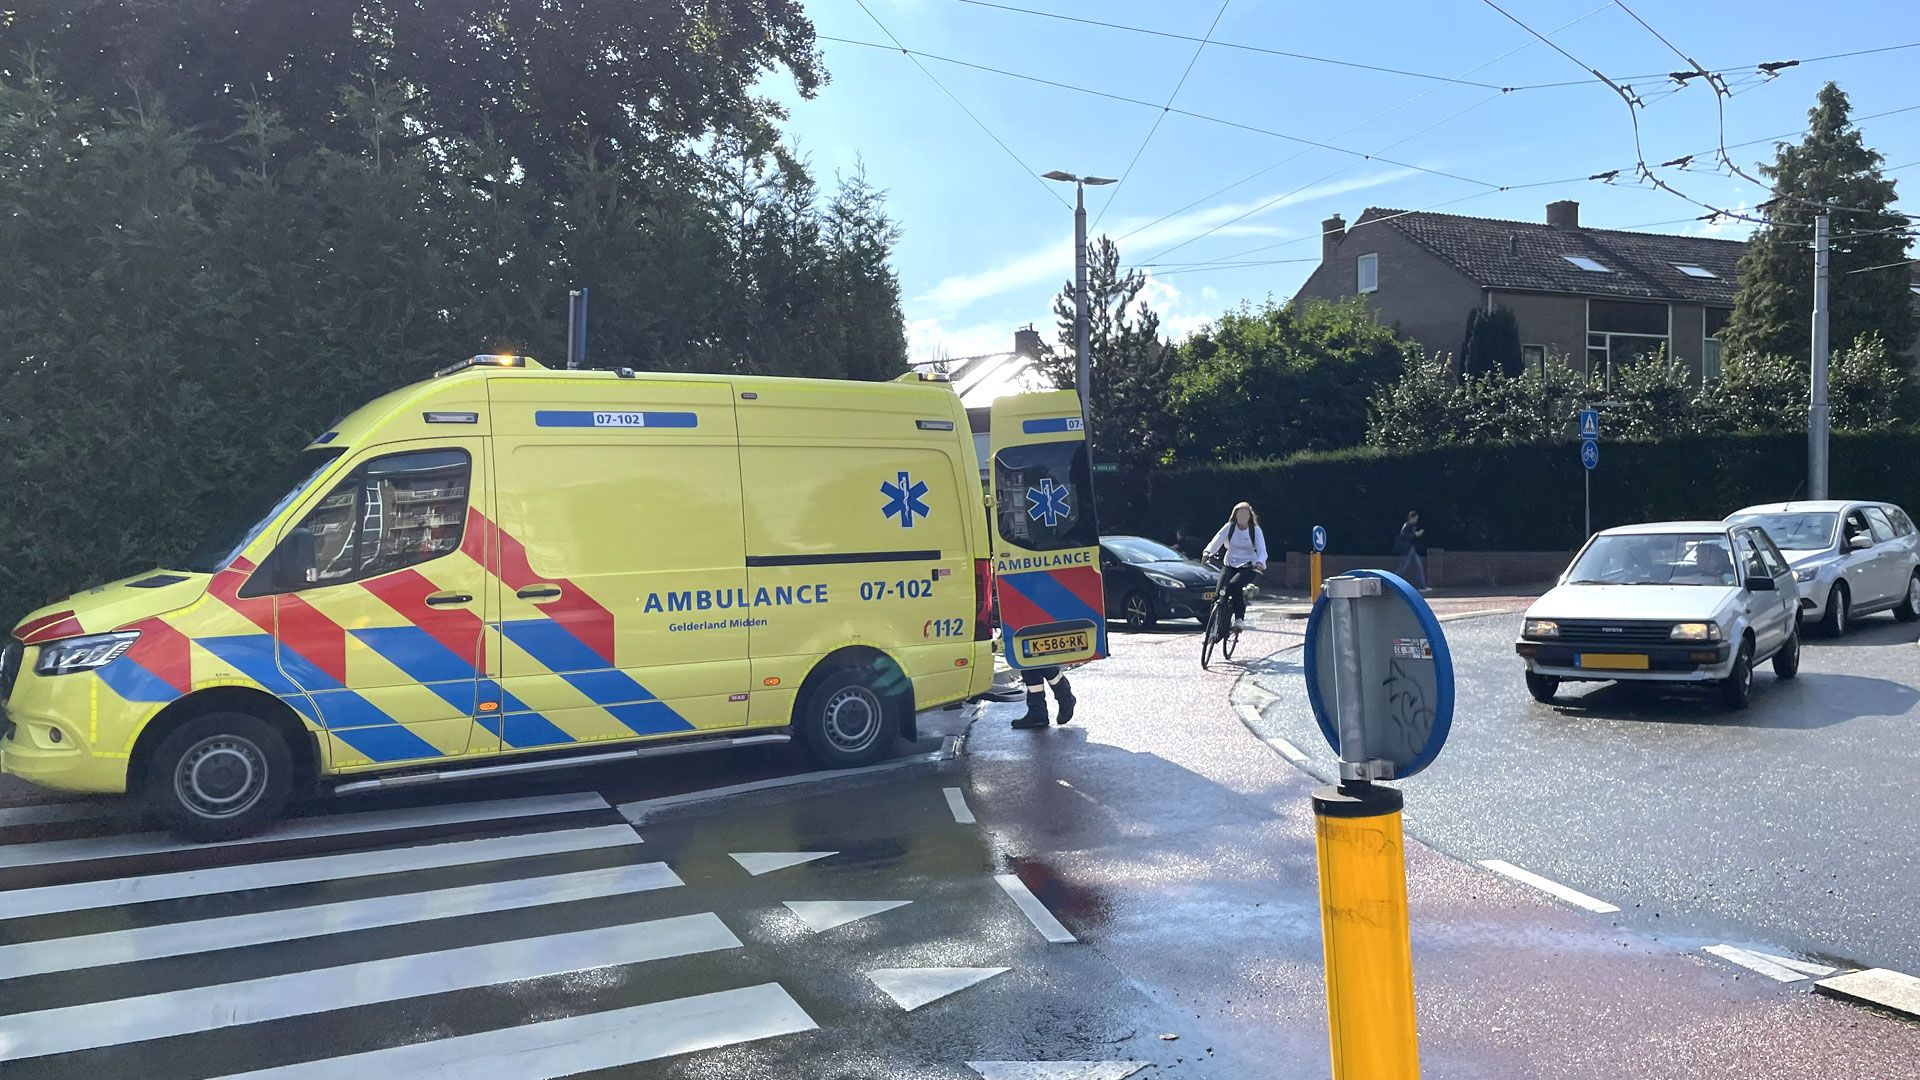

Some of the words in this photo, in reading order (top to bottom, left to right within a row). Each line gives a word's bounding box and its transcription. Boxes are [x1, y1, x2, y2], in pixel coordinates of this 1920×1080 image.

[597, 414, 640, 425] 07-102
[997, 552, 1091, 571] AMBULANCE
[643, 584, 829, 613] AMBULANCE
[860, 579, 932, 600] 07-102
[669, 620, 727, 632] Gelderland
[729, 618, 768, 629] Midden
[1032, 635, 1084, 652] K-586-RK
